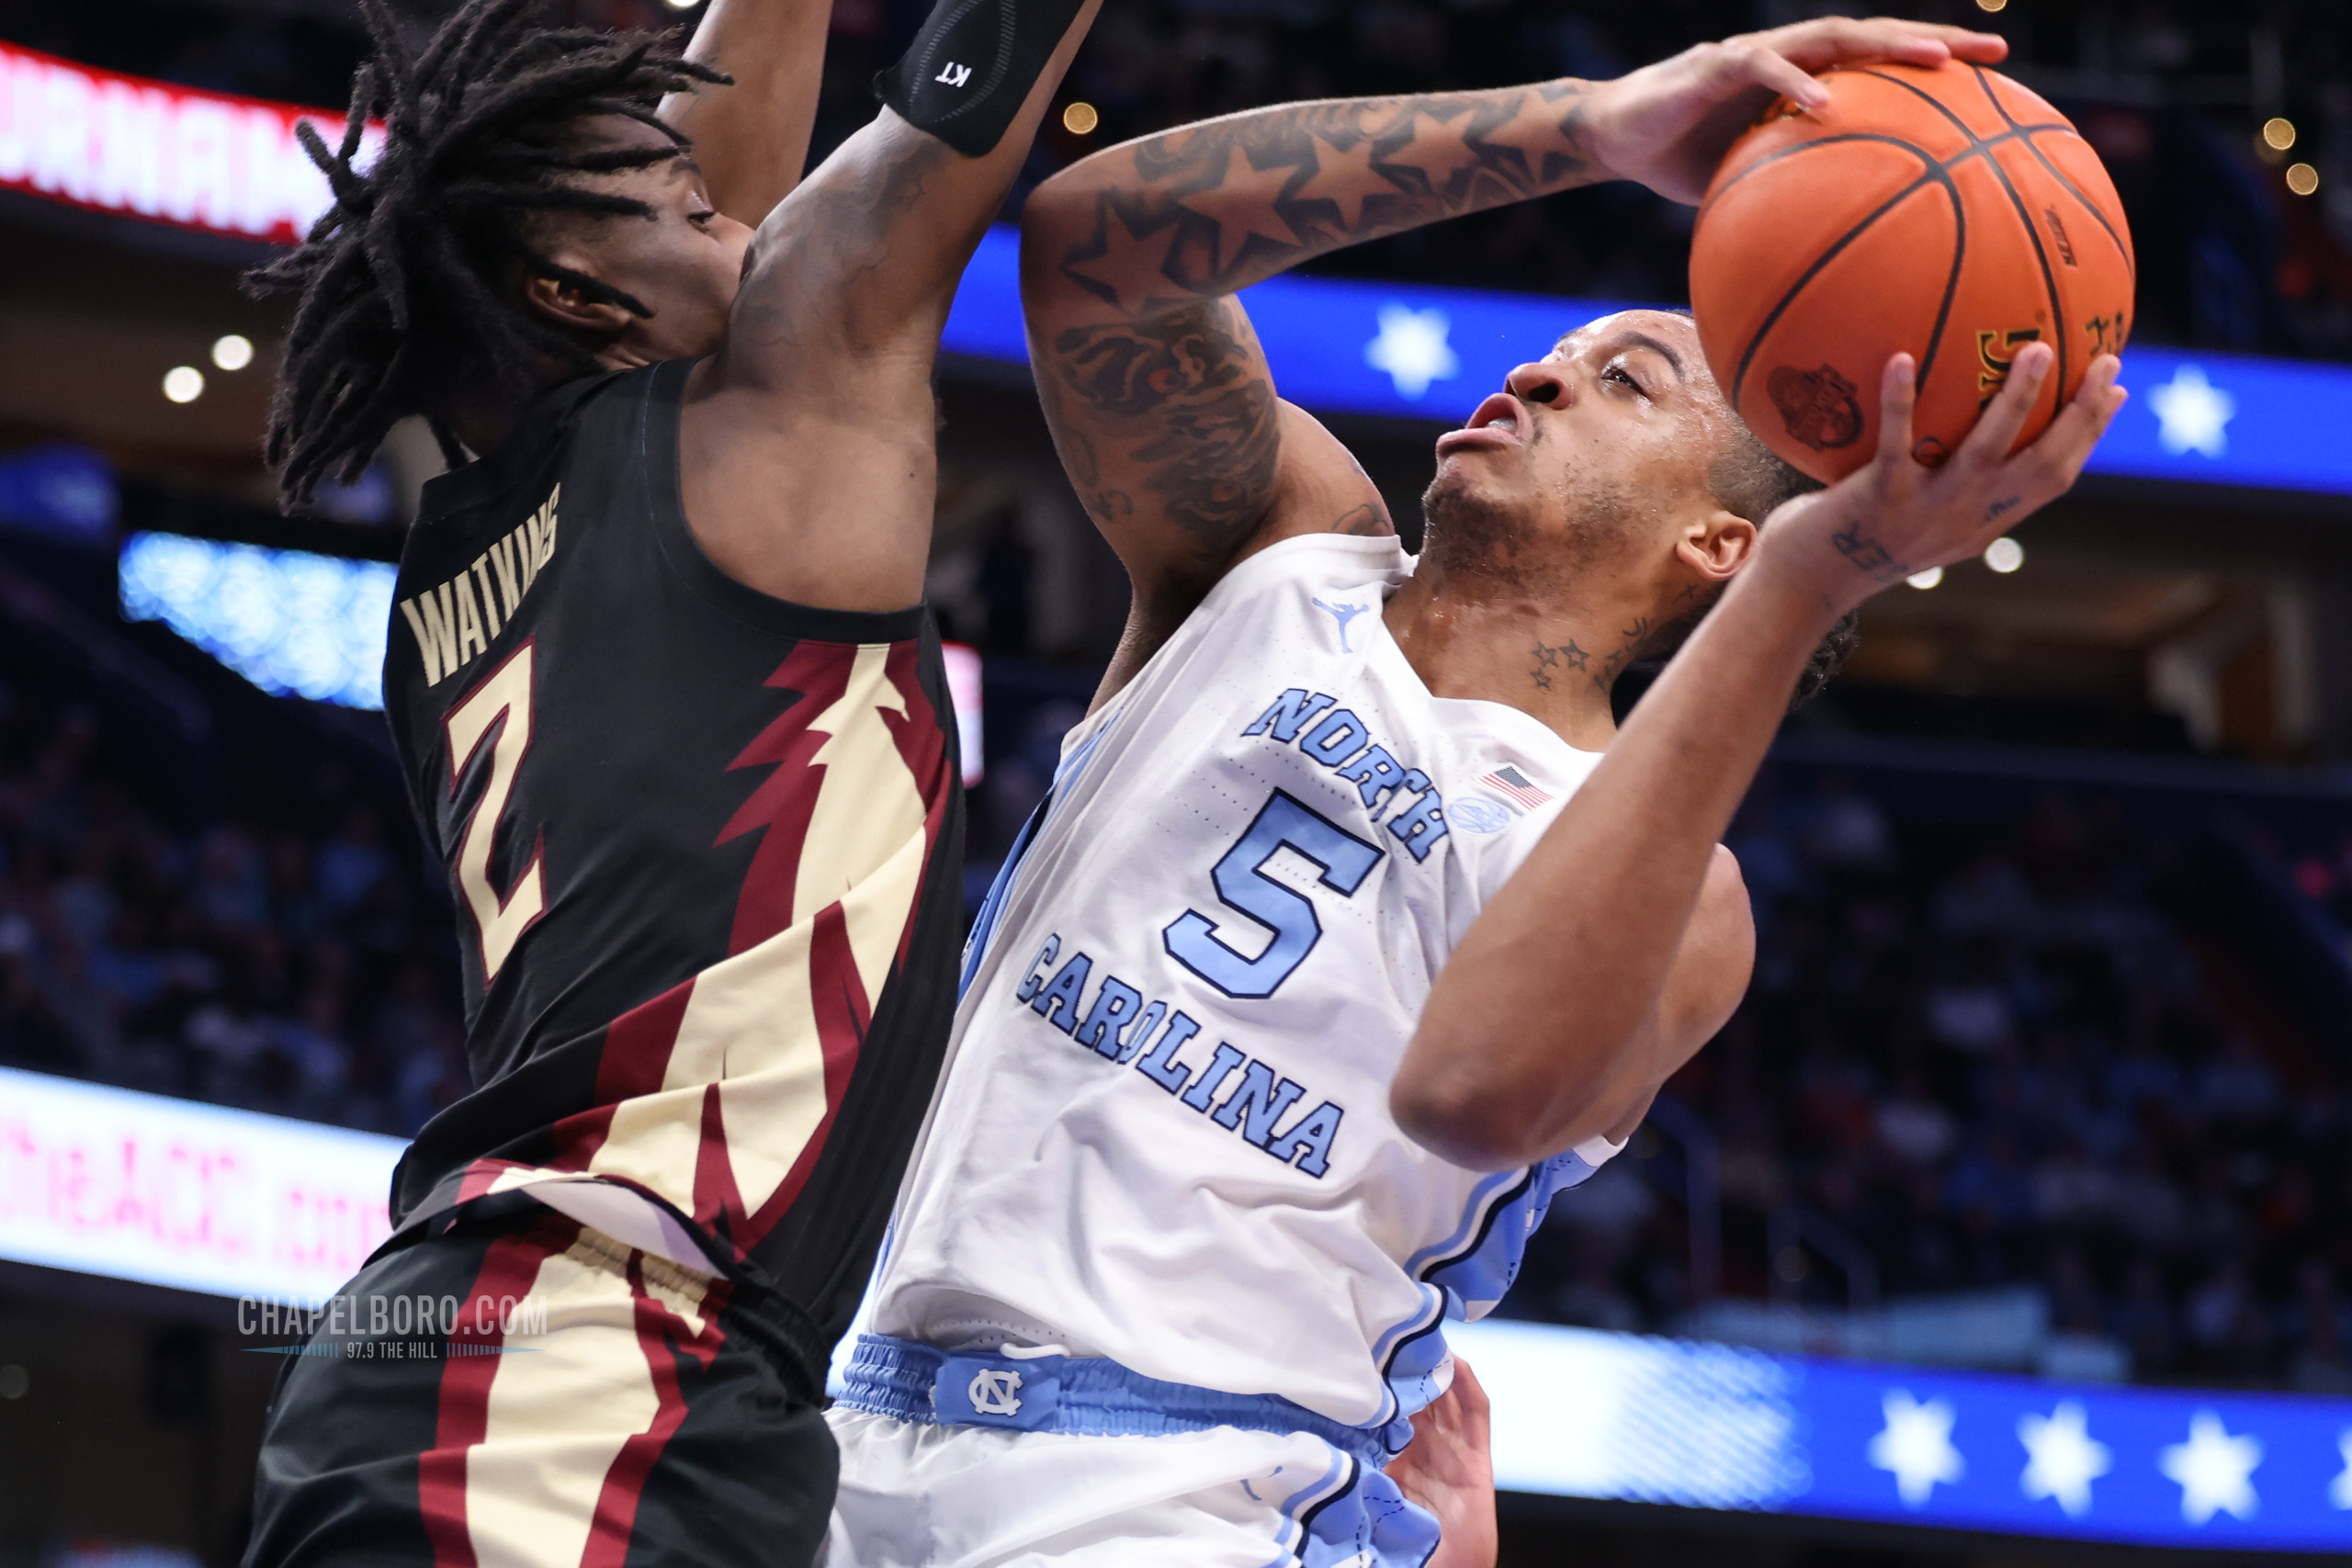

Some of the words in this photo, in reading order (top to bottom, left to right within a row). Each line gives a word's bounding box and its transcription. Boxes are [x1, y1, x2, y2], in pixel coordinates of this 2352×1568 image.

[934, 61, 973, 88] KT
[399, 481, 561, 688] WATKINS
[440, 634, 548, 991] 2
[1162, 786, 1385, 999] 5
[1015, 932, 1345, 1179] CAROLINA
